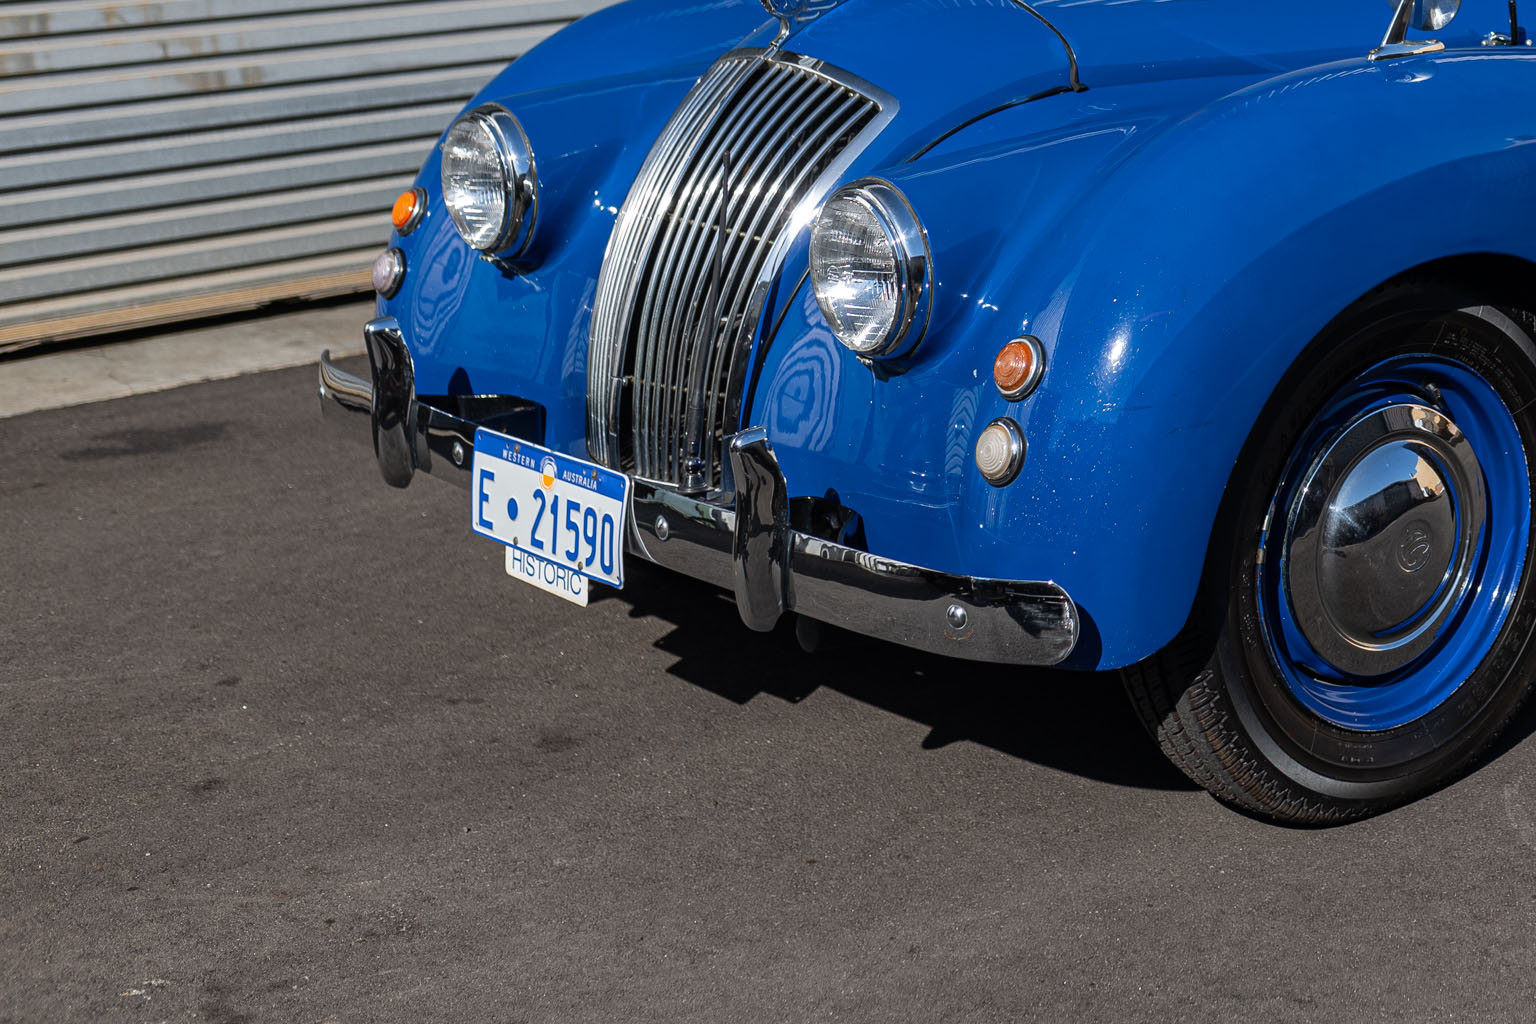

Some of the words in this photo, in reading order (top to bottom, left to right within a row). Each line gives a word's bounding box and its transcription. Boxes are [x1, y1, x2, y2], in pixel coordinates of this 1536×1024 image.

[501, 448, 537, 469] WESTERN
[562, 469, 598, 491] AUSTRALIA
[478, 468, 495, 530] E
[530, 488, 614, 576] 21590
[511, 548, 582, 596] HISTORIC
